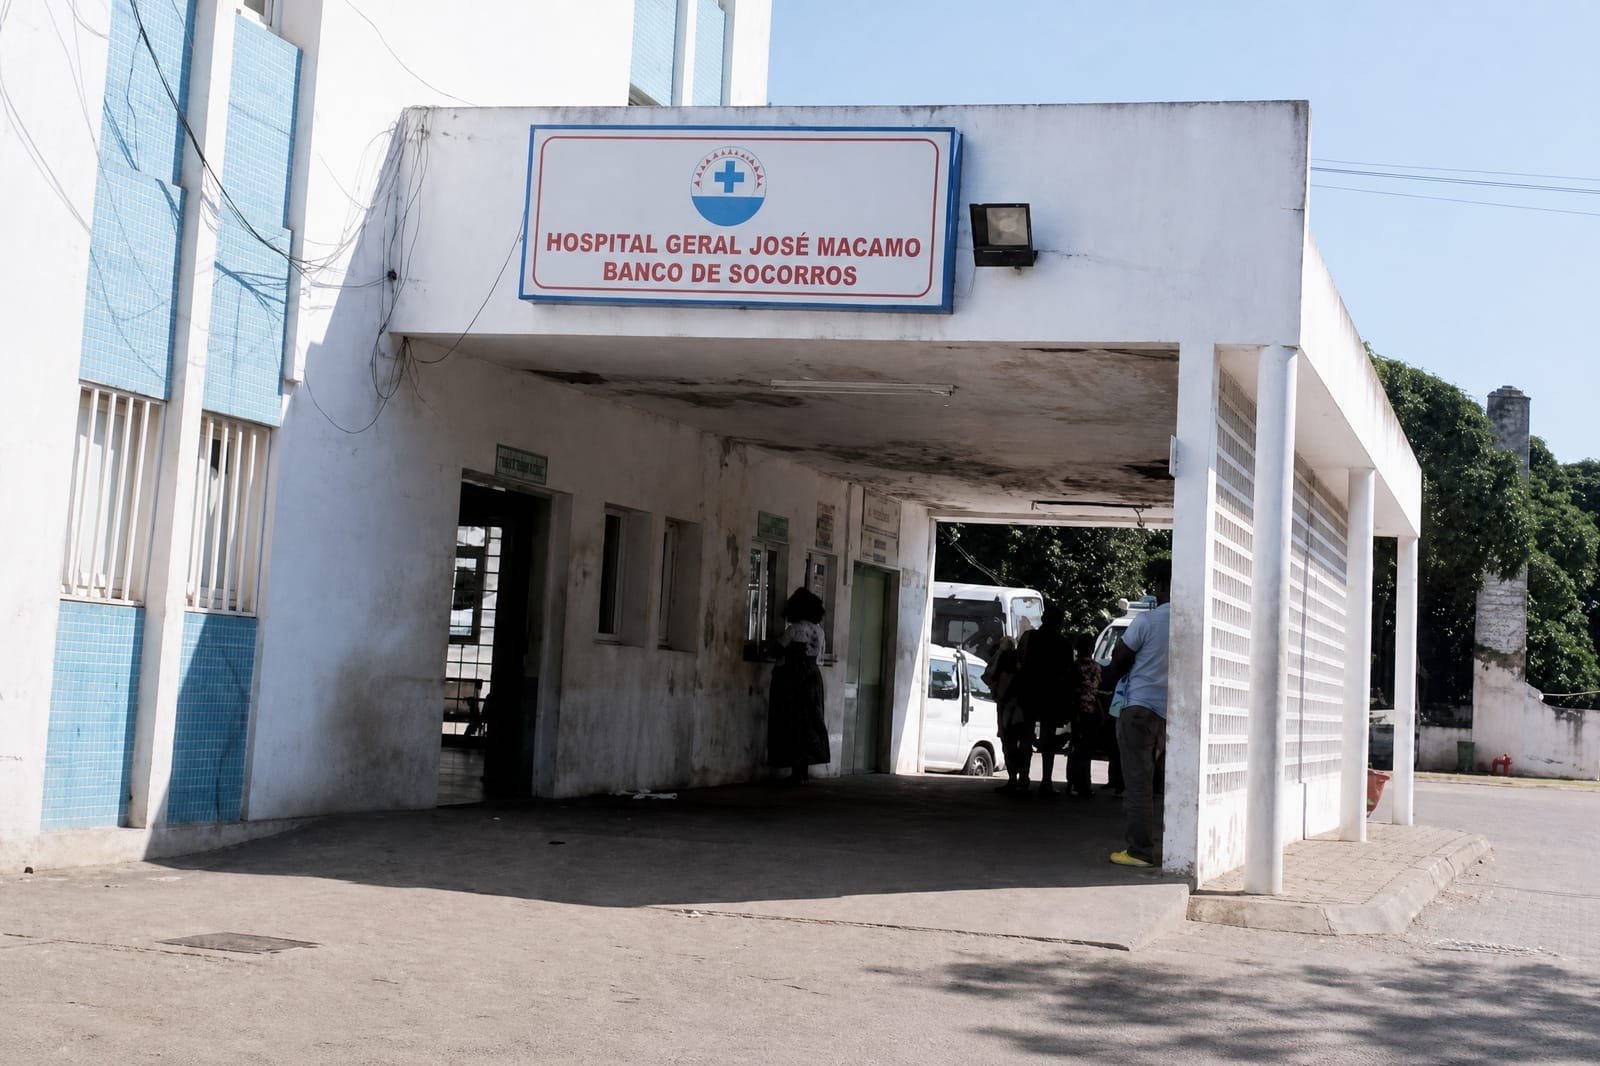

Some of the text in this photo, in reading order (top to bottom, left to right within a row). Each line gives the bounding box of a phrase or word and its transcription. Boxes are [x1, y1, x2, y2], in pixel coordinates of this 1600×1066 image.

[547, 231, 921, 258] HOSPITAL GERAL JOSÉ MACAMO
[603, 261, 857, 286] BANCO DE SOCORROS
